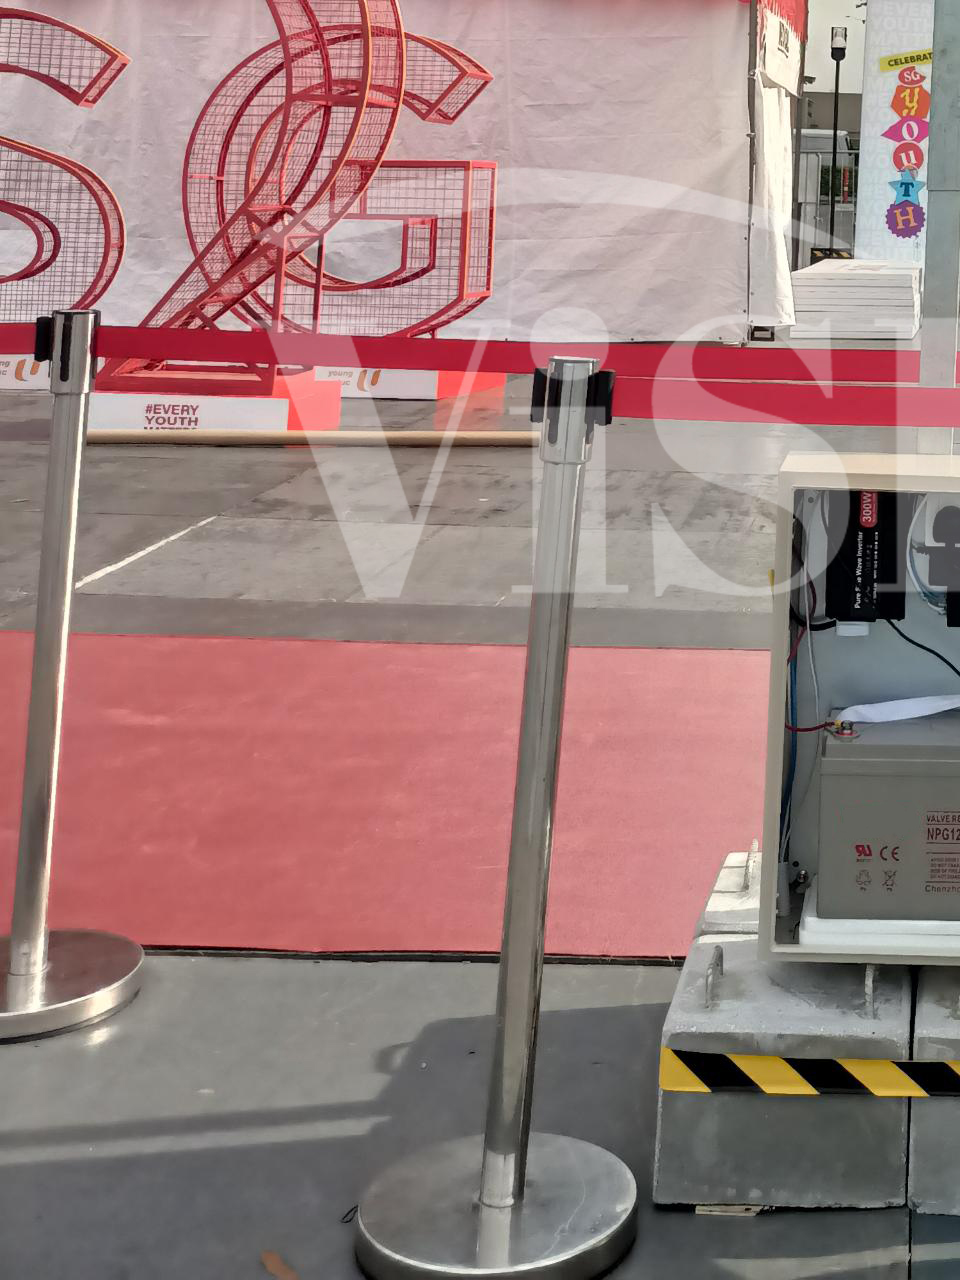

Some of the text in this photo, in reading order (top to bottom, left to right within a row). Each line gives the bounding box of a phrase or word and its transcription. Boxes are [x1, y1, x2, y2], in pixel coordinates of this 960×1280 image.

[887, 52, 933, 67] CELEBRAT
[145, 403, 200, 416] #EVERY
[144, 416, 199, 427] YOUTH
[862, 491, 872, 523] 300W
[926, 814, 952, 823] VALVE
